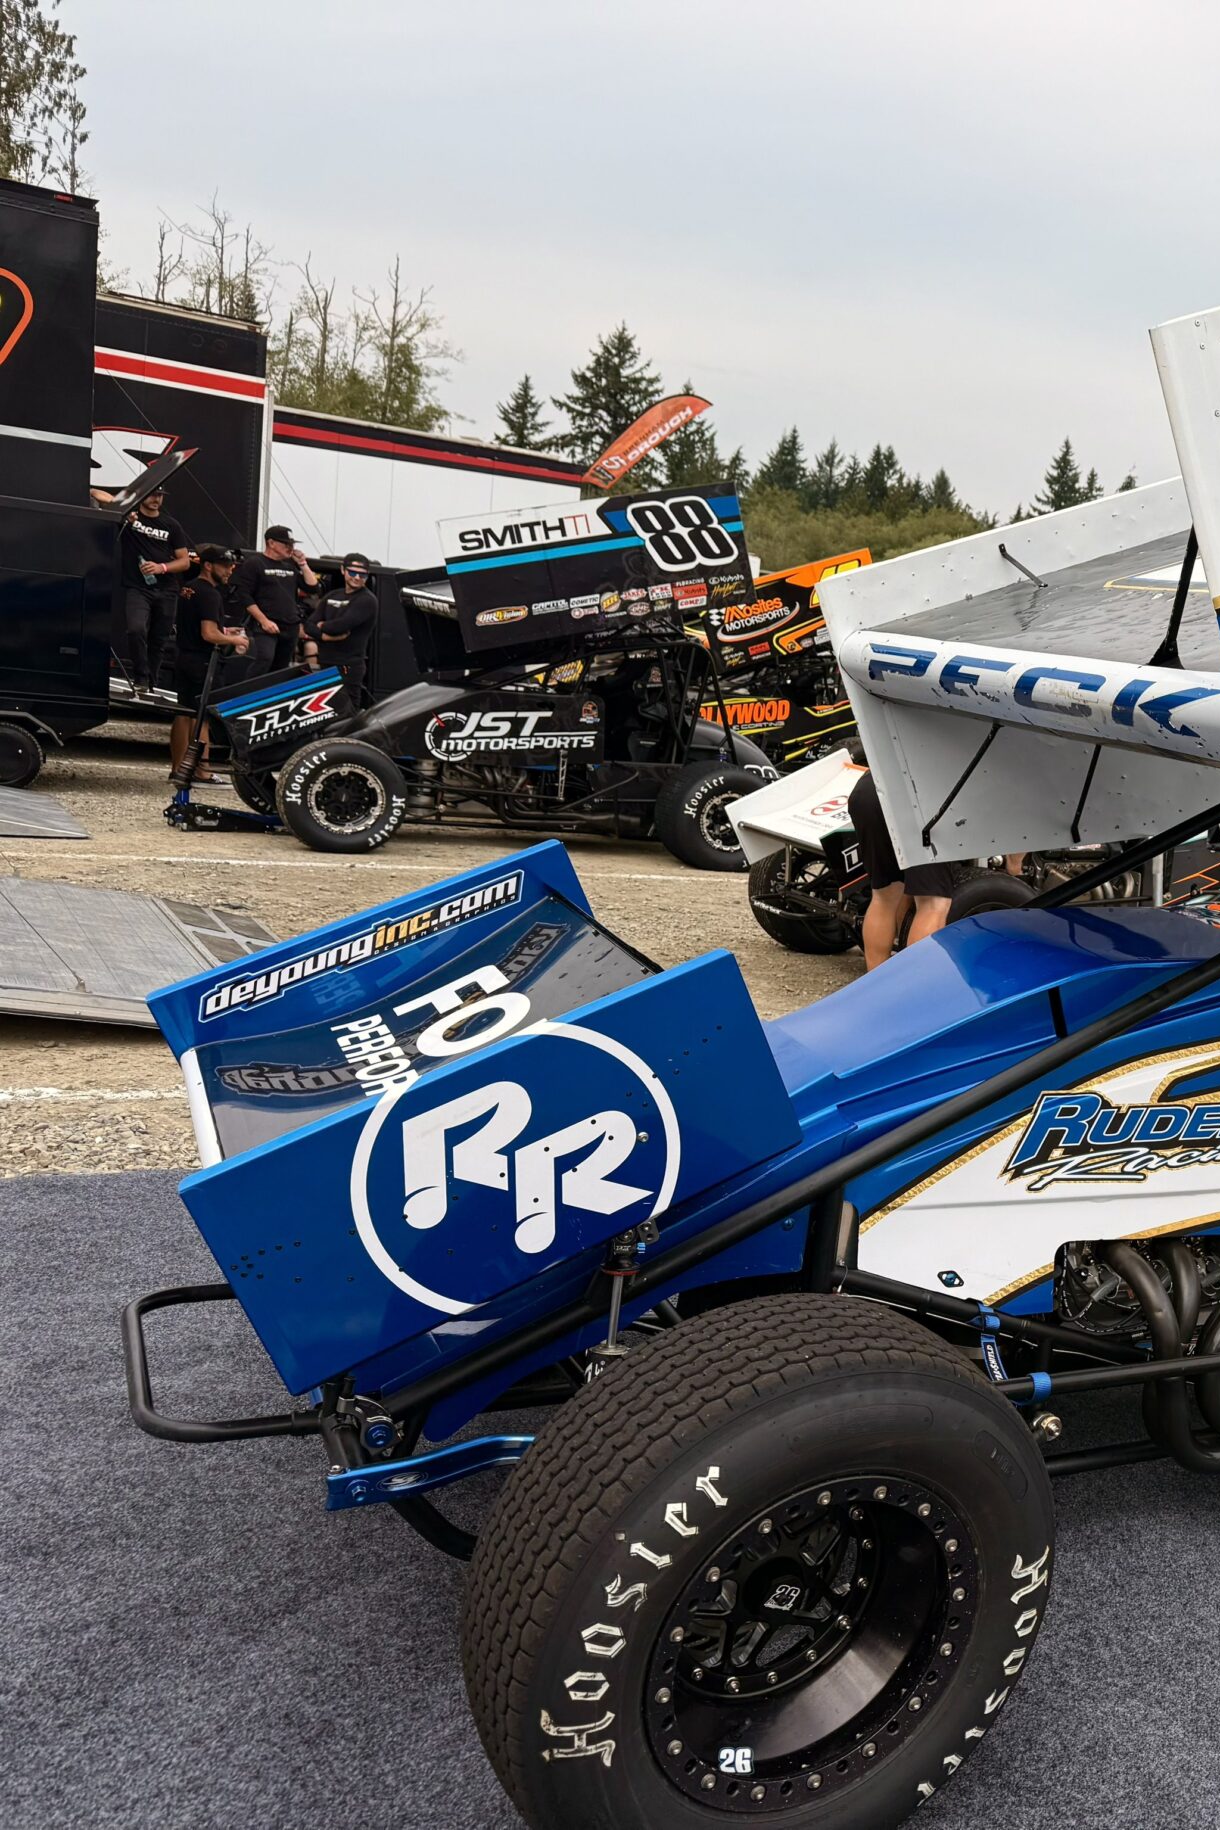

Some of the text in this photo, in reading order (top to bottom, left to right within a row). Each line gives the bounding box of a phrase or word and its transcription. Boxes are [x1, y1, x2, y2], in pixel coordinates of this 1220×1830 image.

[626, 495, 740, 572] 88
[724, 597, 784, 624] Mosites
[725, 606, 791, 633] MOTORSPORTS
[237, 684, 344, 737] FK
[248, 712, 337, 745] FACTORY KAHNE
[449, 711, 553, 738] JST
[699, 699, 791, 730] OLLYWOOD
[441, 735, 596, 752] MOTORSPORTS
[285, 750, 328, 806] Hoosier
[683, 776, 725, 819] Hoosier
[367, 794, 406, 847] Hoosier
[205, 875, 518, 1016] deyounginc.com
[374, 930, 428, 956] DESIGN
[445, 894, 517, 928] GRAPHICS
[391, 963, 532, 1057] FO
[330, 1013, 423, 1097] PERFOR
[540, 1465, 729, 1769] Hoosier
[916, 1544, 1051, 1808] Hoosier
[717, 1745, 755, 1776] 26
